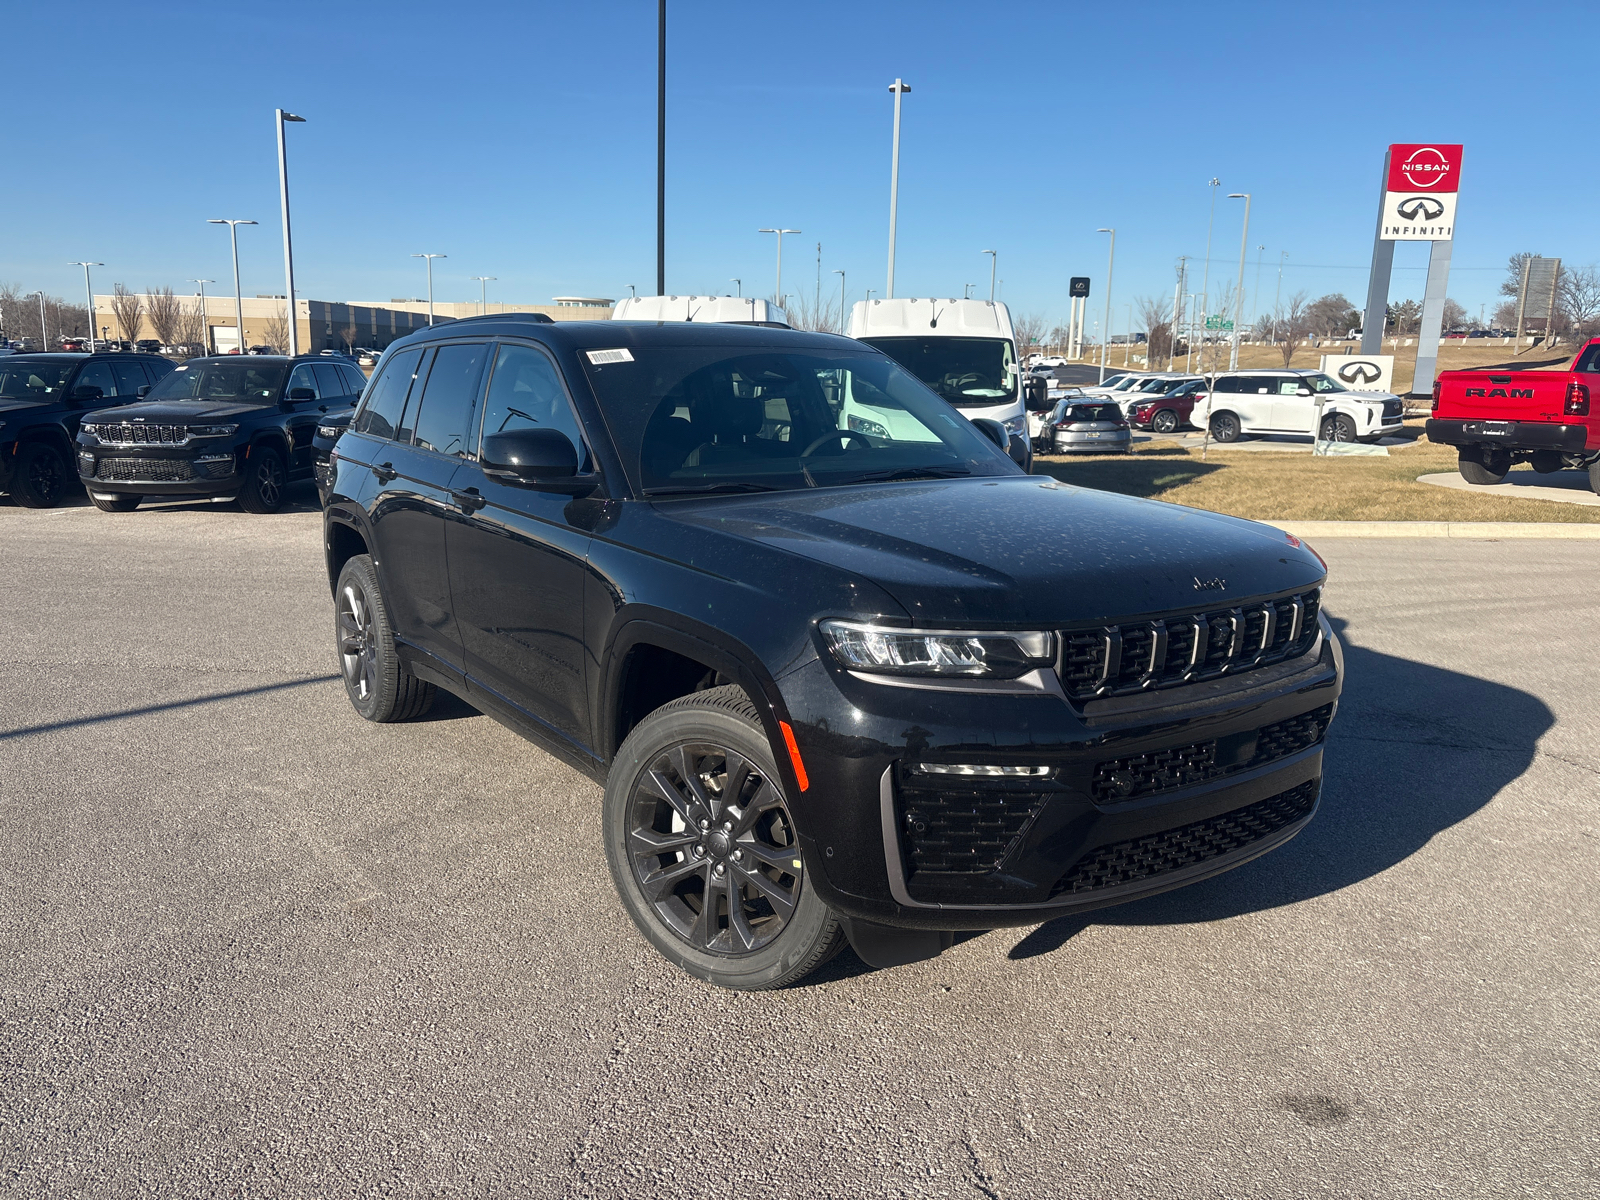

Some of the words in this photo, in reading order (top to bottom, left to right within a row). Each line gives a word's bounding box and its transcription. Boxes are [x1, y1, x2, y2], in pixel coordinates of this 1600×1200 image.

[1385, 226, 1451, 235] INFINITI
[1465, 388, 1534, 398] RAM
[1193, 576, 1226, 591] Jeep
